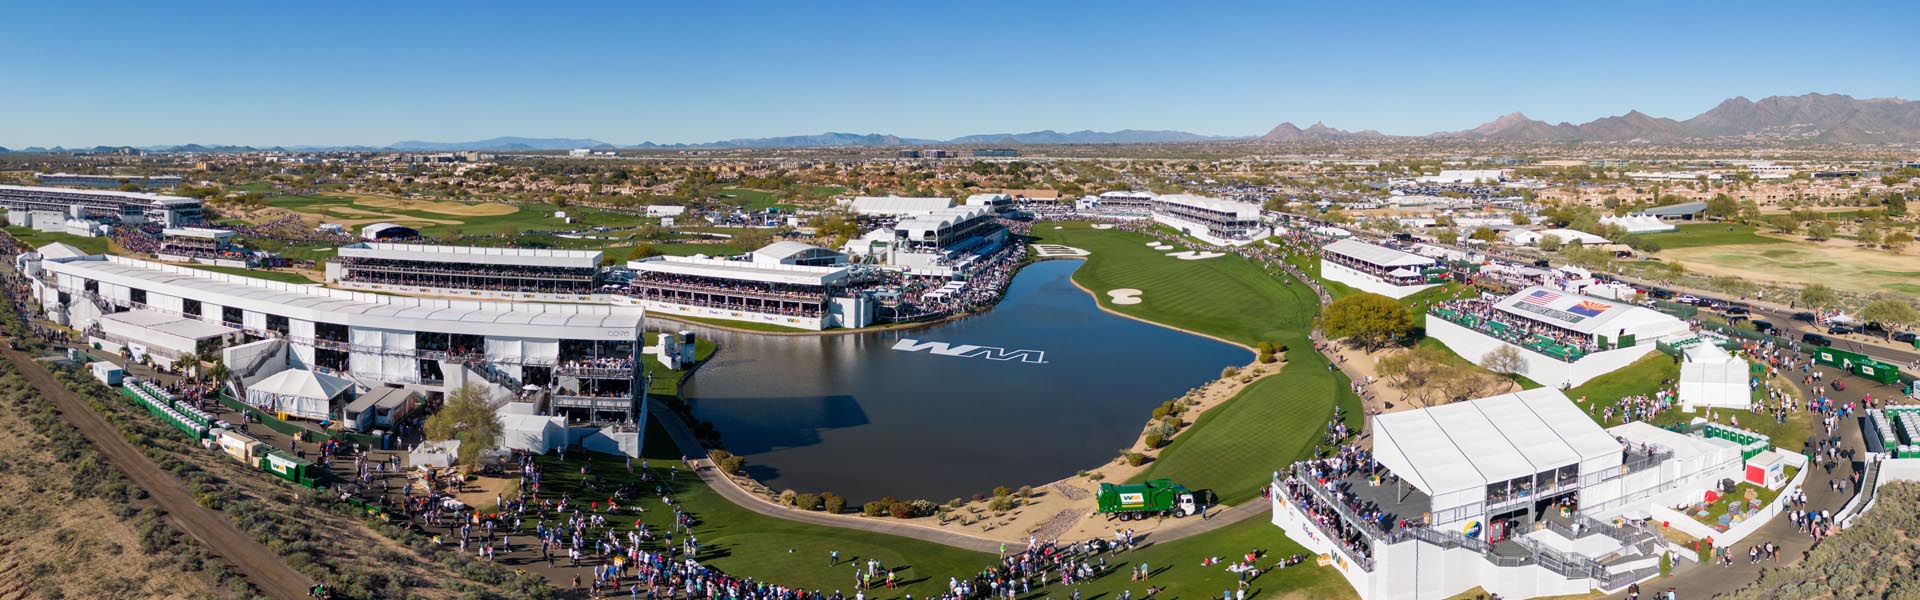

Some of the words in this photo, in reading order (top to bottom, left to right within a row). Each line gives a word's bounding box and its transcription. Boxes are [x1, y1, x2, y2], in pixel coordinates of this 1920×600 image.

[891, 338, 1045, 363] WM
[272, 463, 285, 472] WM
[1276, 490, 1287, 508] WM
[1331, 549, 1349, 573] WM
